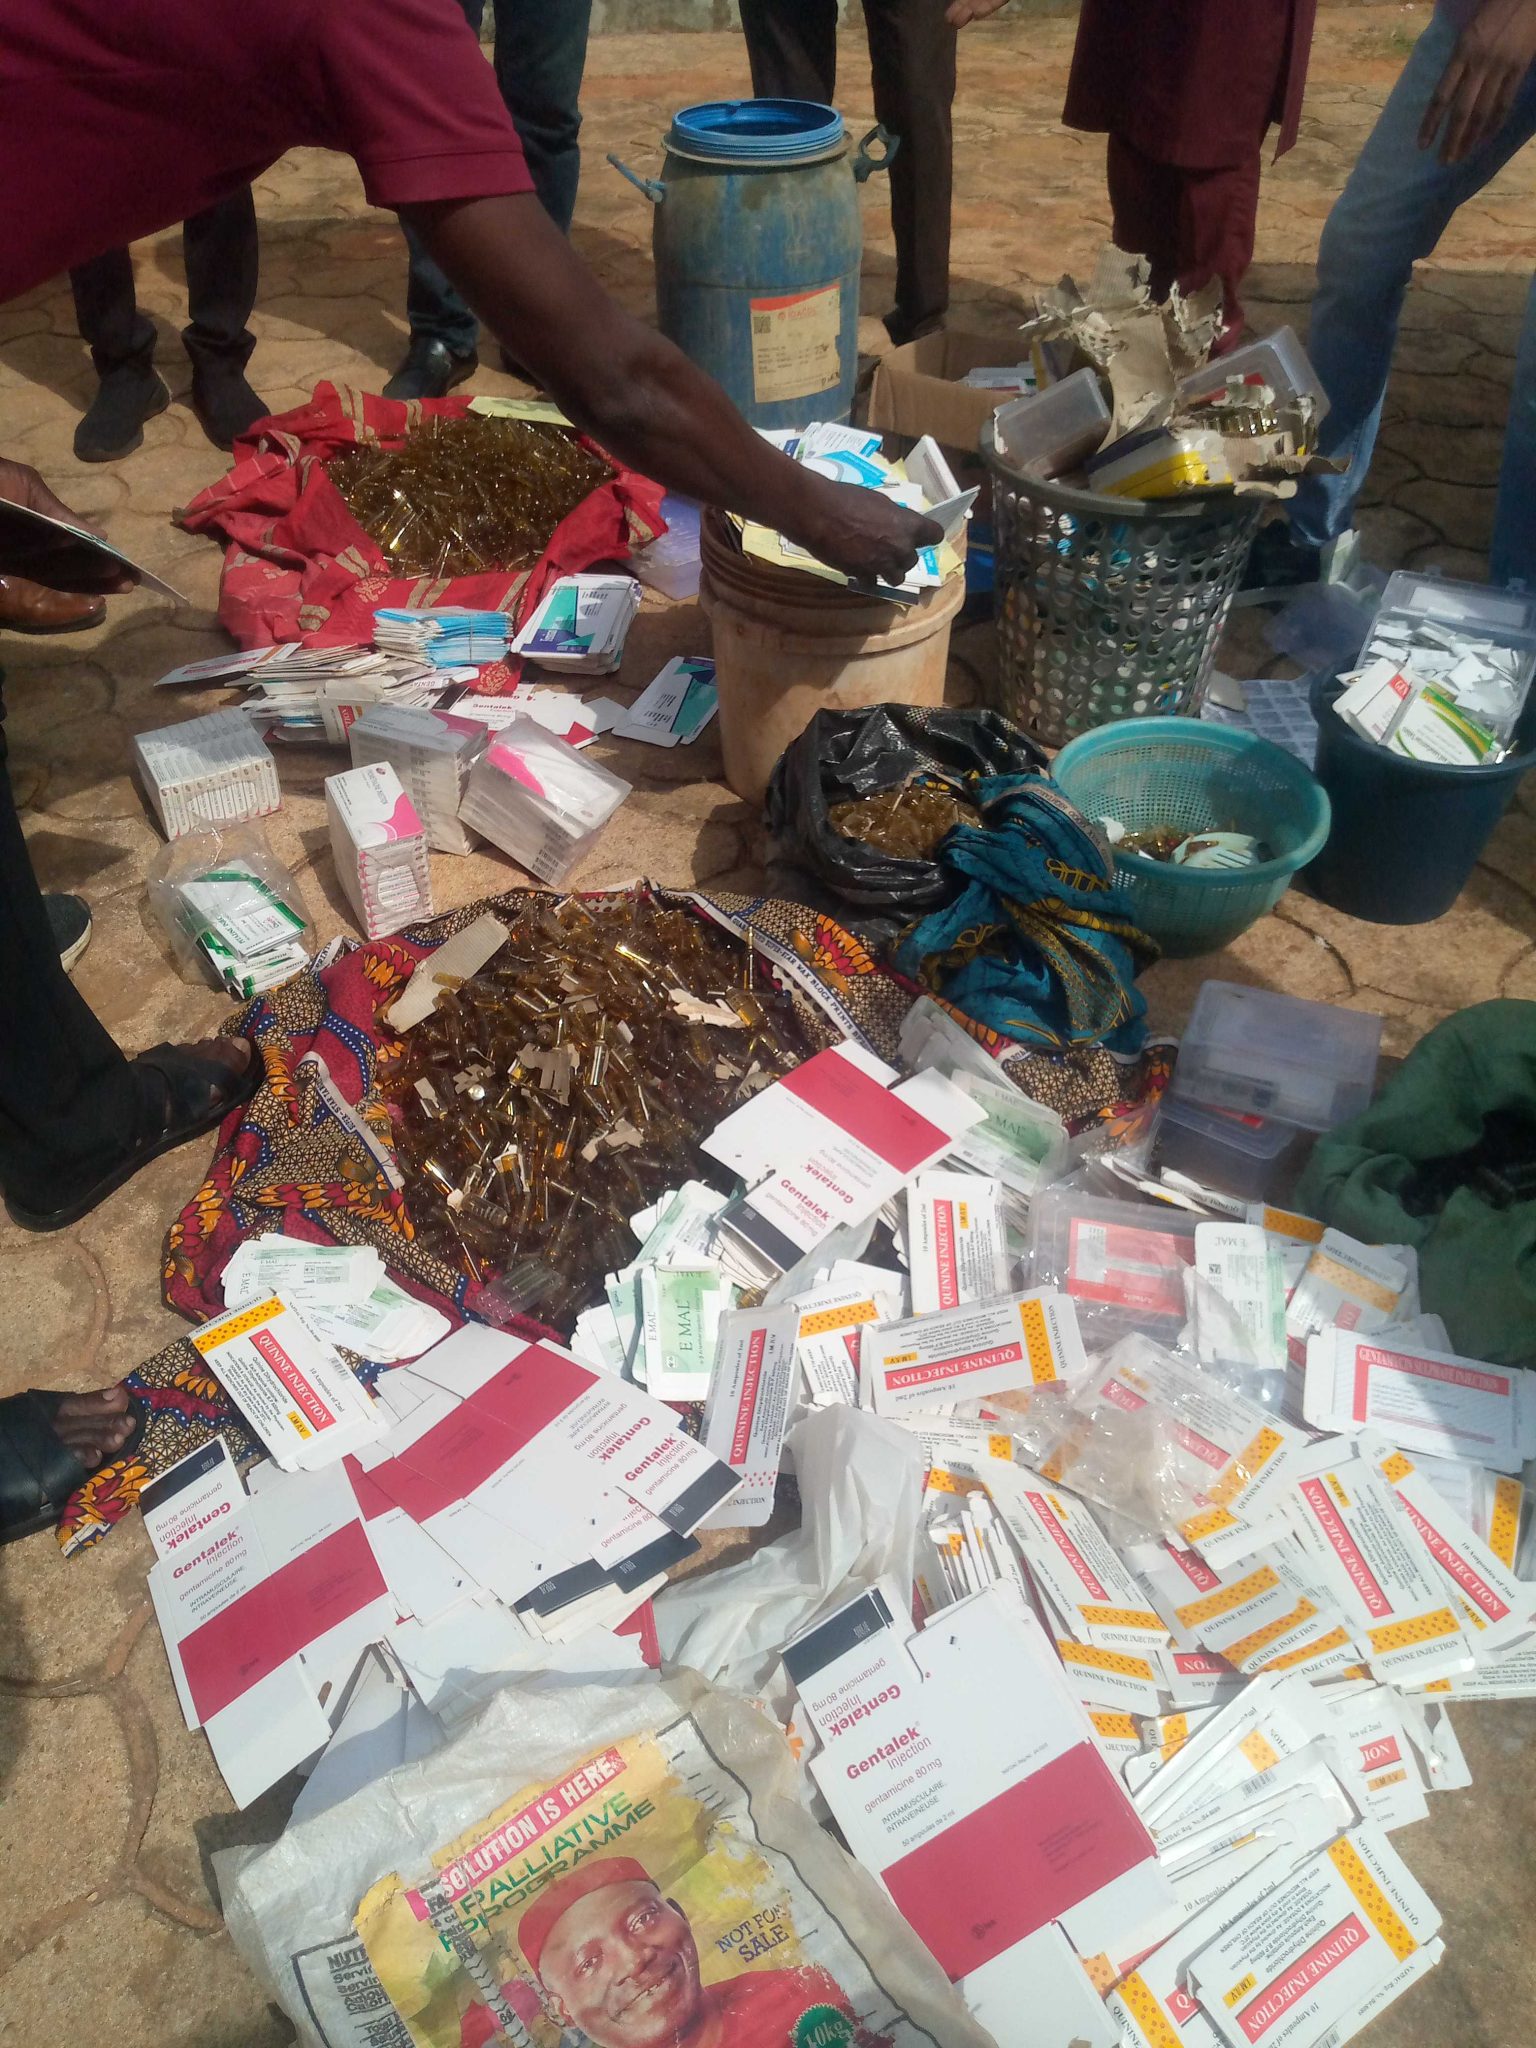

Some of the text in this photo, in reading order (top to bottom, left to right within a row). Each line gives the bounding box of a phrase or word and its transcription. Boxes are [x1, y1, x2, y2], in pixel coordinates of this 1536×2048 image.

[798, 965, 810, 979] WAX
[810, 980, 830, 1001] BLOCK
[831, 1003, 851, 1030] PRINTS
[780, 1179, 831, 1221] Gentalek
[804, 1164, 853, 1204] Gentalek
[935, 1204, 952, 1304] QUININE INJECTION
[678, 1300, 693, 1351] E MAL
[1048, 1305, 1066, 1368] QUININE INJECTION
[251, 1355, 289, 1405] Quinine Dihydrochloride
[259, 1335, 293, 1377] QUININE
[288, 1371, 329, 1423] INJECTION
[313, 1373, 333, 1398] Ampoules
[891, 1348, 1016, 1387] QUININE INJECTION
[1454, 1369, 1498, 1389] INJECTION
[731, 1335, 761, 1457] QUININE INJECTION
[601, 1417, 651, 1462] Gentalek
[624, 1436, 677, 1482] Gentalek
[657, 1440, 688, 1467] Injection
[646, 1462, 680, 1496] gentamicine
[180, 1482, 223, 1517] gentamicine
[160, 1513, 197, 1543] Injection
[167, 1502, 231, 1550] Gentalek
[601, 1518, 642, 1548] gentamicine
[1031, 1497, 1070, 1550] INJECTION
[173, 1530, 237, 1579] Gentalek
[206, 1536, 244, 1565] Injection
[1306, 1487, 1382, 1610] QUININE INJECTION
[1404, 1506, 1441, 1548] UININE
[1440, 1544, 1500, 1612] INJECTION
[180, 1566, 223, 1602] gentamicine
[1069, 1550, 1100, 1595] QUININE
[1205, 1591, 1278, 1633] QUININE INJECTION
[1101, 1632, 1129, 1642] QUININE
[1248, 1623, 1319, 1670] QUININE INJECTION
[1415, 1639, 1458, 1659] INJECTION
[839, 1658, 886, 1695] gentamicine
[1073, 1669, 1148, 1692] QUININE INJECTION
[1301, 1652, 1346, 1675] INJECTION
[819, 1694, 861, 1726] Injection
[829, 1684, 901, 1737] Gentalek
[846, 1726, 920, 1780] Gentalek
[887, 1736, 932, 1770] Injection
[864, 1776, 915, 1813] gentamicine
[887, 1795, 939, 1833] INTRAVEINEUSE
[439, 1755, 616, 1898] SOLUTION IS HERE
[459, 1792, 633, 1915] PALLIATIVE
[1275, 1882, 1300, 1904] MEDICINES
[1358, 1837, 1419, 1926] QUININE INJECTION
[1243, 1914, 1262, 1931] REACH
[1266, 1900, 1278, 1912] OUT
[715, 1921, 753, 1954] NOT
[738, 1924, 790, 1963] SALE
[1261, 1918, 1327, 1974] Quinine Dihydrochloride
[333, 1966, 373, 1984] Servin
[337, 1977, 381, 1994] Servin
[1247, 1928, 1360, 2032] QUININE INJECTION
[1277, 2006, 1312, 2037] Ampoules
[1308, 2001, 1319, 2012] 10
[804, 2020, 850, 2048] 10kg
[1113, 2006, 1142, 2048] QUININE
